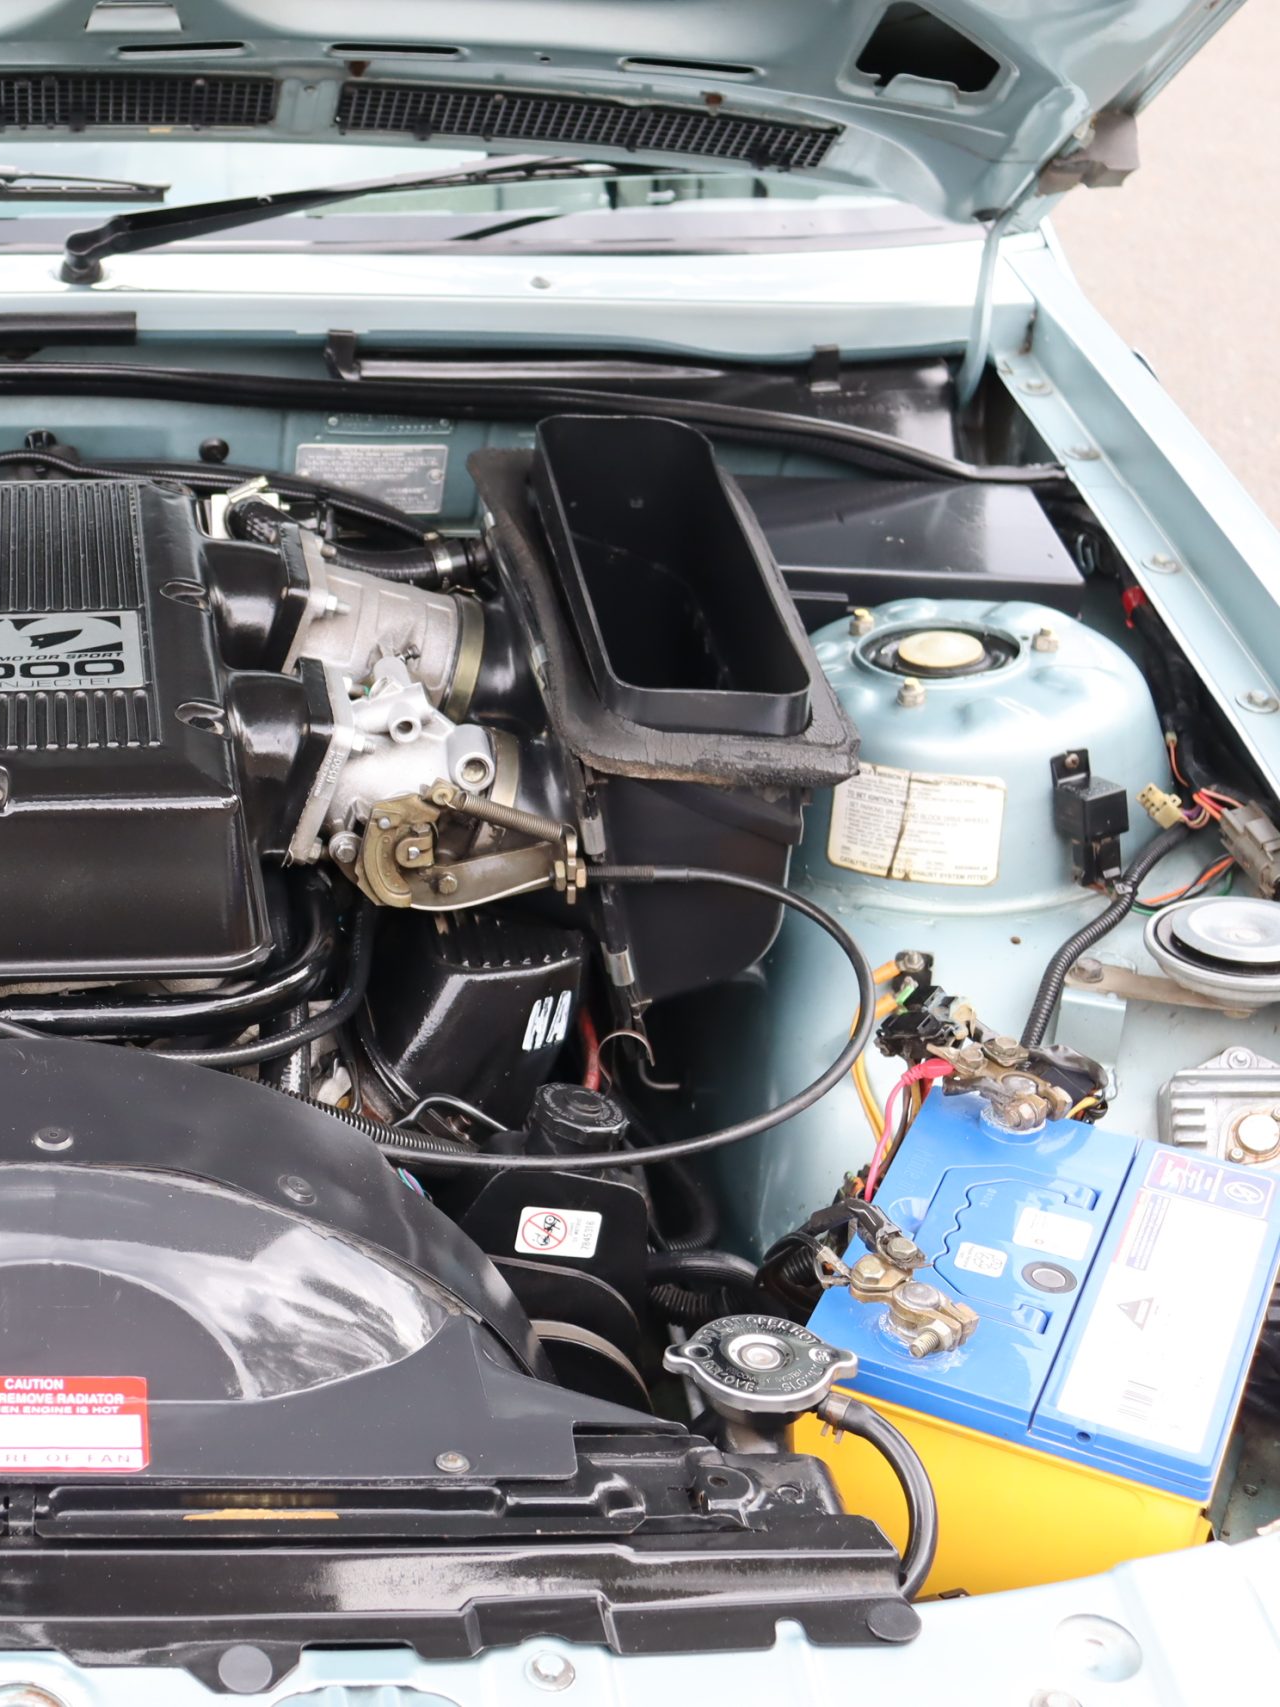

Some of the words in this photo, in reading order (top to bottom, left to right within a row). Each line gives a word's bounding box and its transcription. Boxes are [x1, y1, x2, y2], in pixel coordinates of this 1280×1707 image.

[65, 651, 124, 660] SPORT
[4, 1378, 64, 1391] CAUTION
[56, 1393, 126, 1405] RADIATOR
[22, 1405, 73, 1415] ENGINE
[76, 1405, 89, 1414] IS
[91, 1405, 121, 1414] HOT
[45, 1453, 72, 1463] OF
[87, 1453, 131, 1463] FAN
